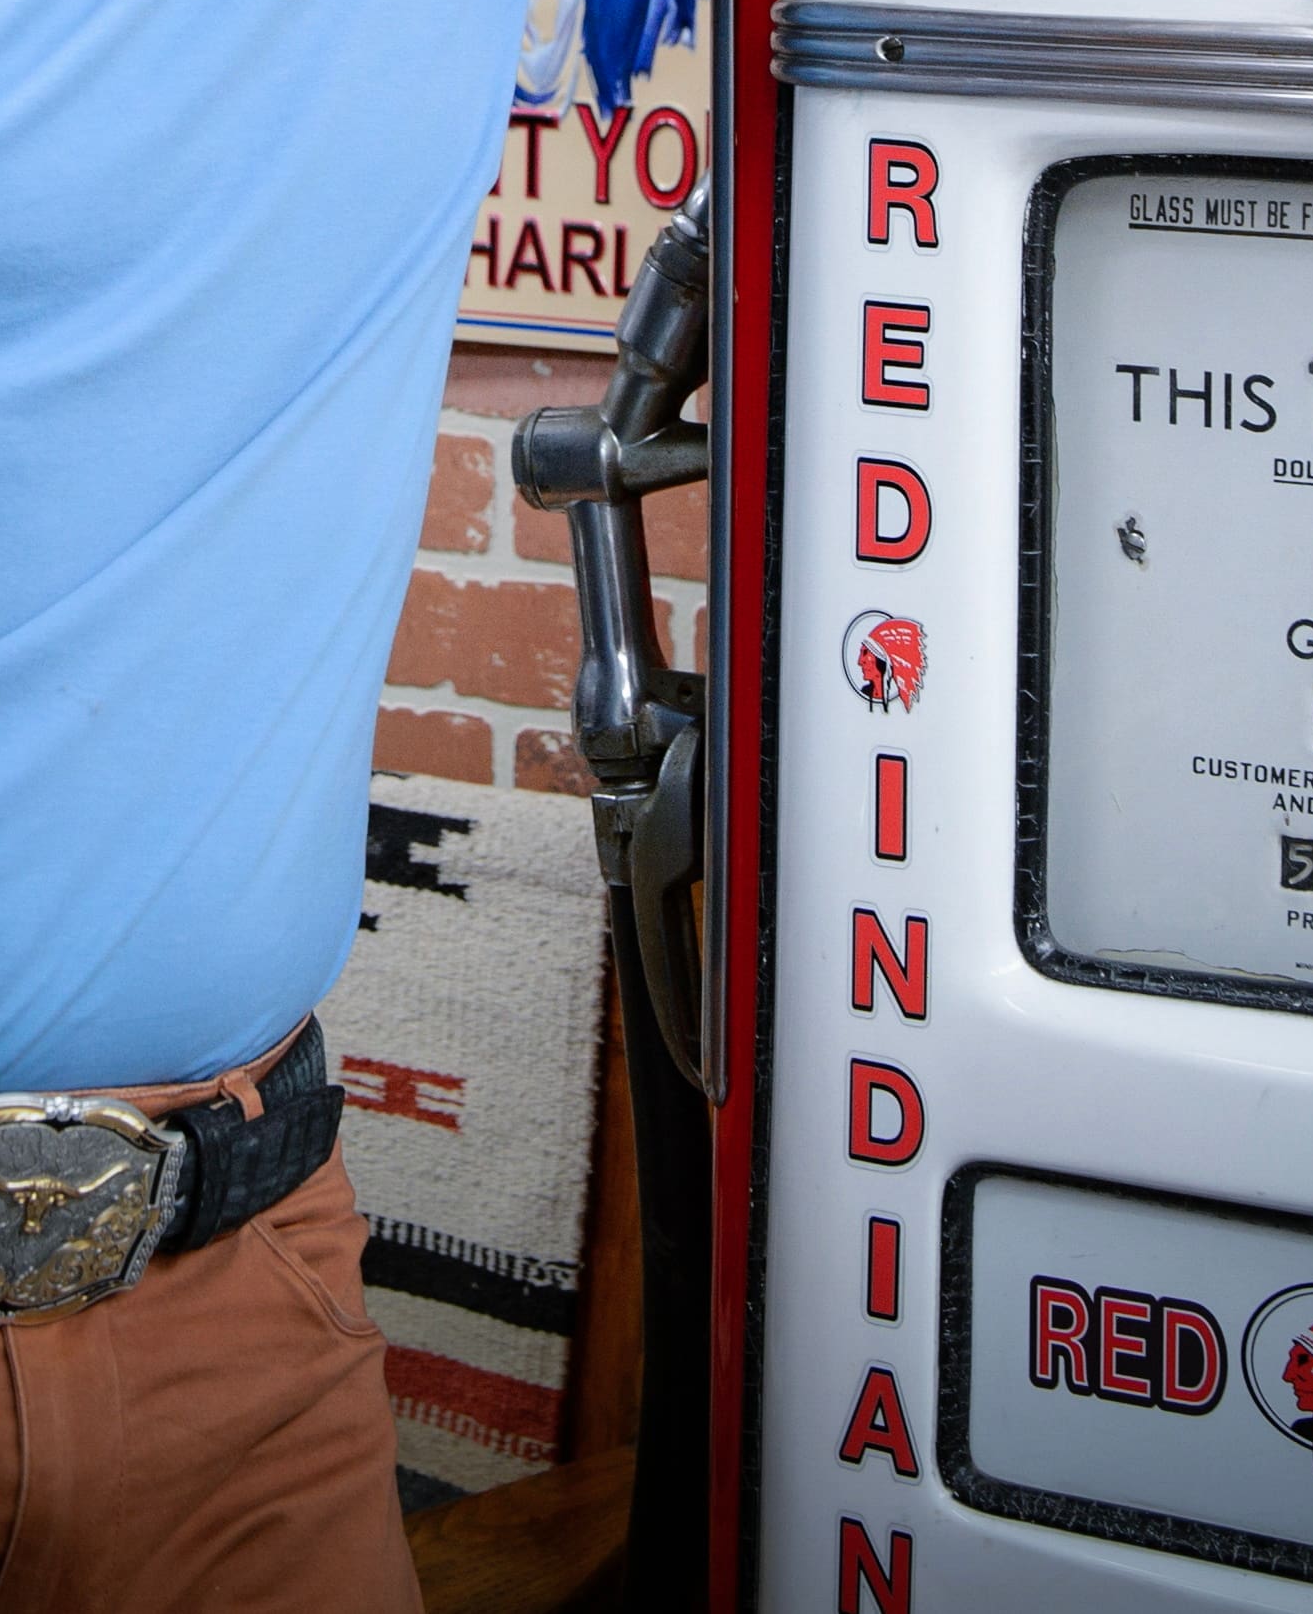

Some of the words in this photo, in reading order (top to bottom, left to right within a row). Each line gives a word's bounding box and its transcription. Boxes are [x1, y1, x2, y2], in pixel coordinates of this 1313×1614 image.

[488, 106, 559, 199] T
[573, 103, 710, 209] YO
[465, 214, 647, 298] HARL
[1129, 194, 1194, 225] GLASS
[1205, 198, 1257, 228] MUST
[1267, 200, 1290, 229] BE
[855, 137, 940, 565] RED
[1115, 364, 1277, 433] THIS
[1029, 1275, 1228, 1416] RED
